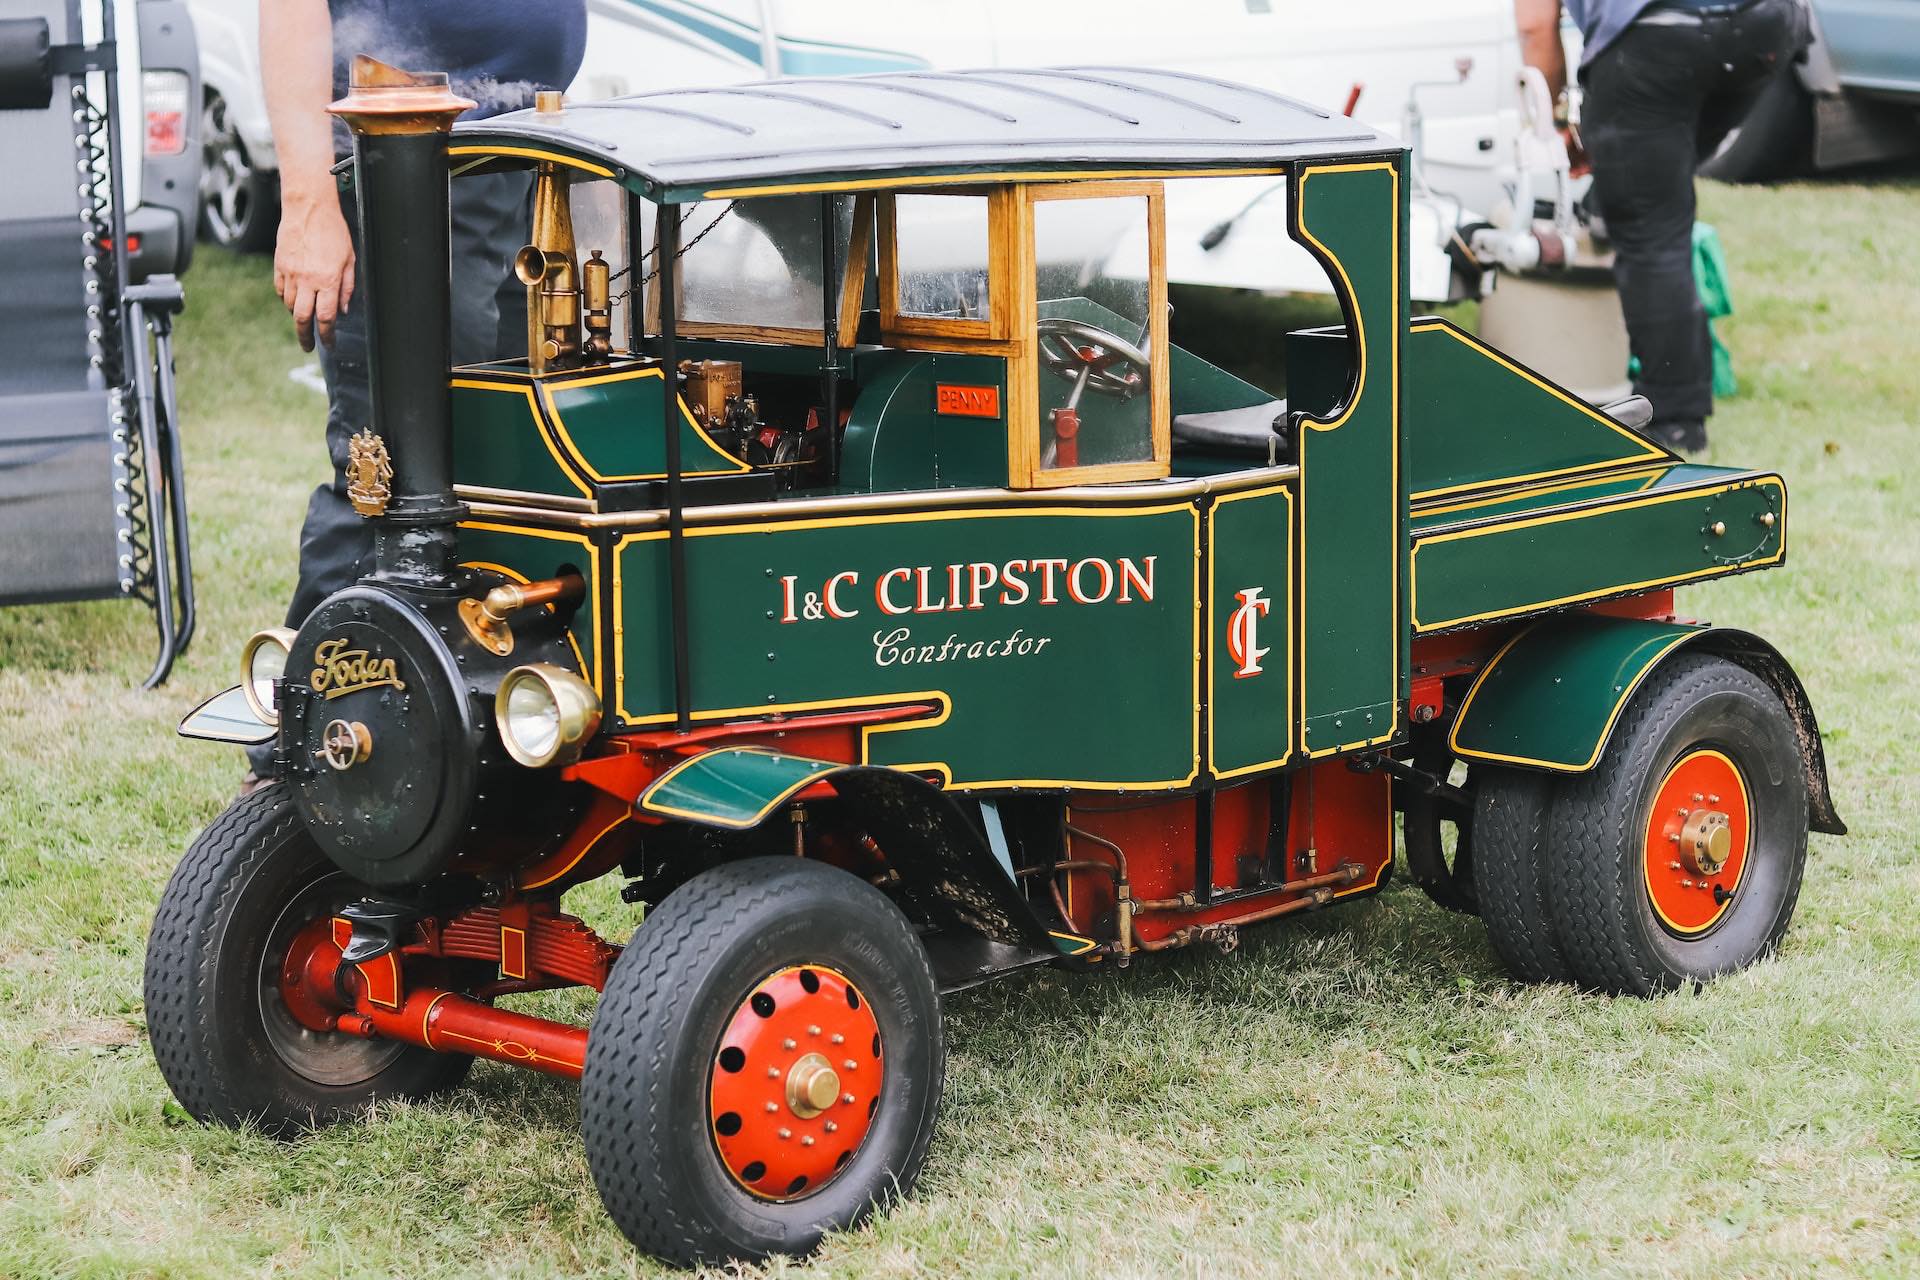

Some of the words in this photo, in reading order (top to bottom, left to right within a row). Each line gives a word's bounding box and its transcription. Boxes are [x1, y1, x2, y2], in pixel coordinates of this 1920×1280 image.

[940, 390, 993, 410] PENNY
[780, 571, 859, 624] I&C
[875, 556, 1157, 616] CLIPSTON
[311, 638, 406, 700] Foden
[872, 627, 1051, 667] Contractor
